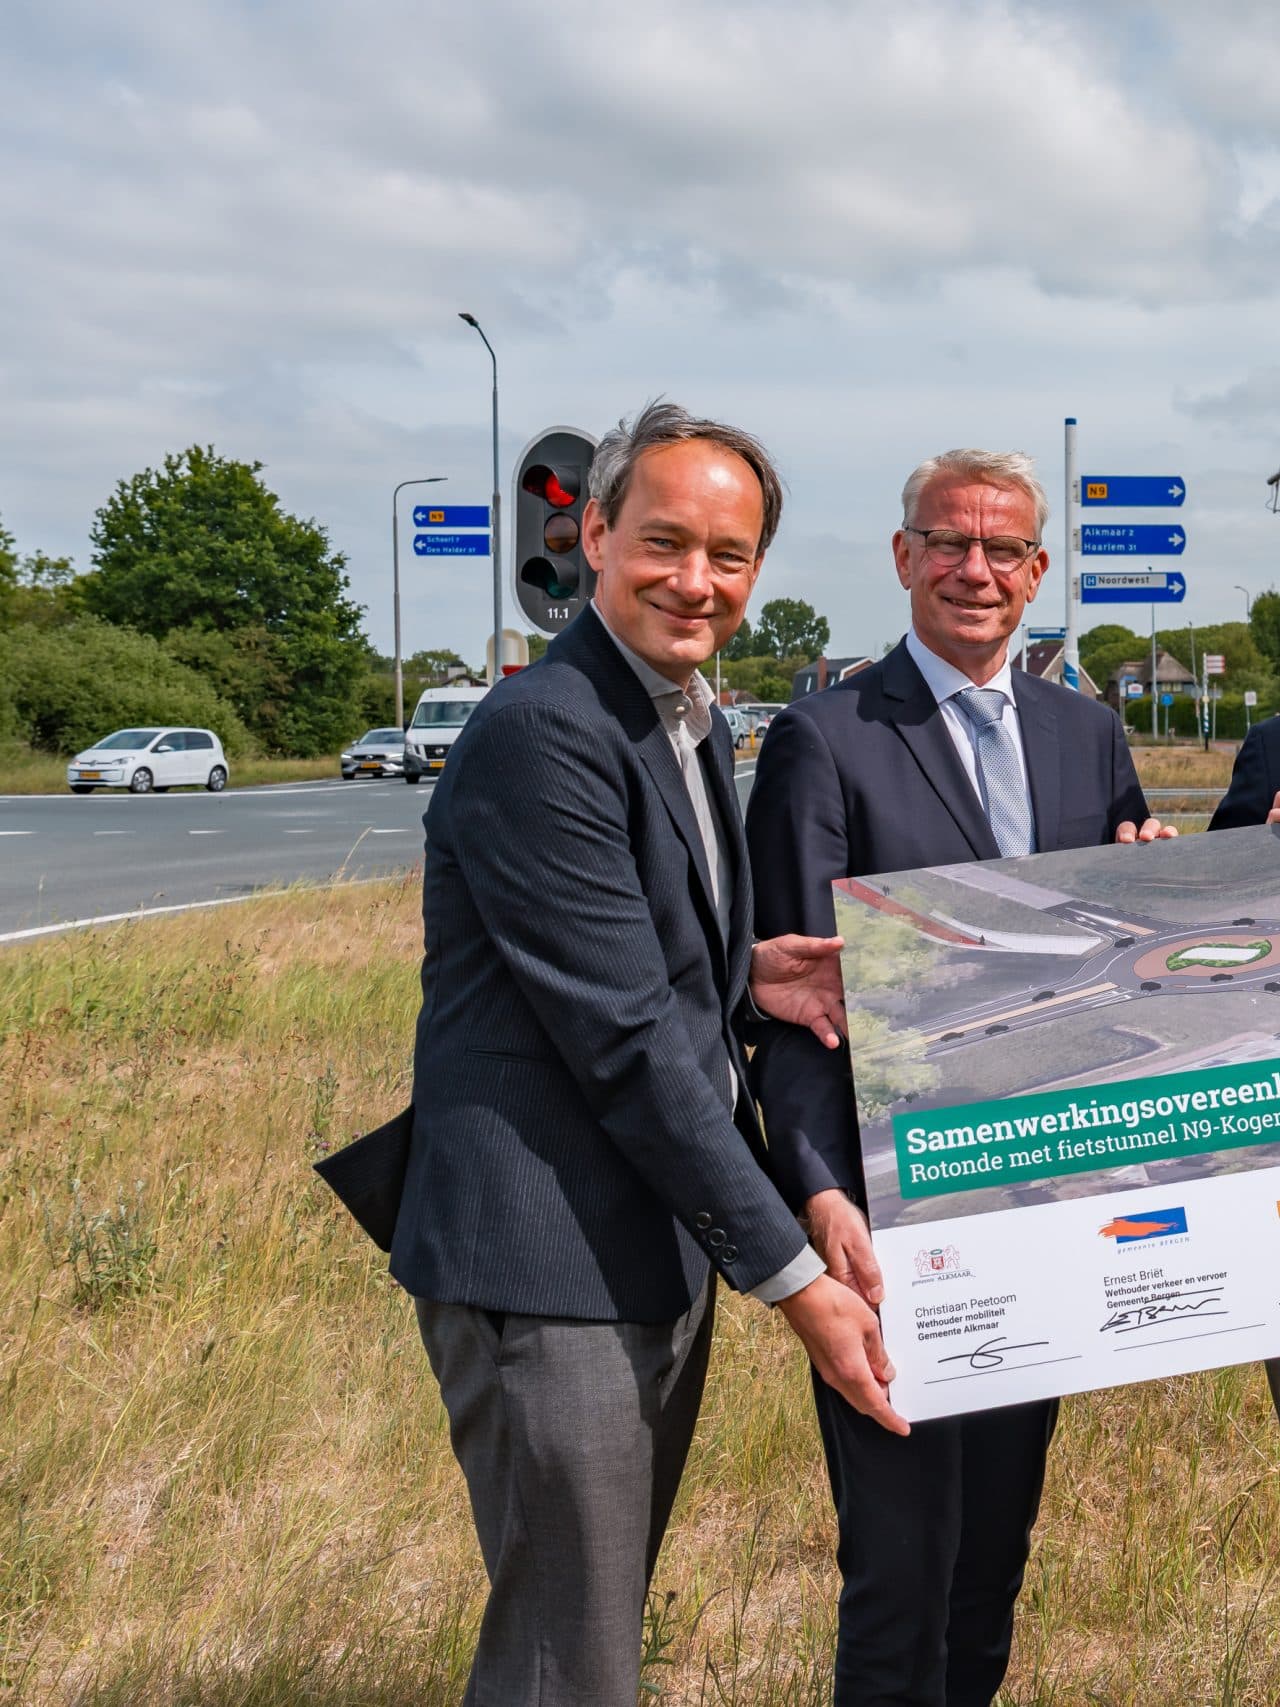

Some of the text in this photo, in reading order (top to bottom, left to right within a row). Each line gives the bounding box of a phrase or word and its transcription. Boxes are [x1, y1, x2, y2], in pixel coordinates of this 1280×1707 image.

[1084, 528, 1126, 537] Alkmaar
[1084, 543, 1125, 551] Haarlem
[1098, 576, 1150, 584] Noordwest
[548, 608, 569, 619] 11.1
[910, 1151, 1003, 1184] Rotonde
[1009, 1145, 1051, 1168] met
[1057, 1124, 1178, 1160] fietstunnel
[1117, 1237, 1190, 1255] gemeente BERGEN
[937, 1270, 976, 1281] ALKMAAR
[1103, 1268, 1163, 1287] Ernest Briët
[1105, 1271, 1228, 1298] Wethouder verkeer en vervoer
[915, 1293, 1017, 1318] Christiaan Peetoom
[1107, 1291, 1181, 1309] Gemeente Bergen
[916, 1308, 1005, 1329] Wethouder mobiliteit
[918, 1321, 999, 1341] Gemeente Alkmaar
